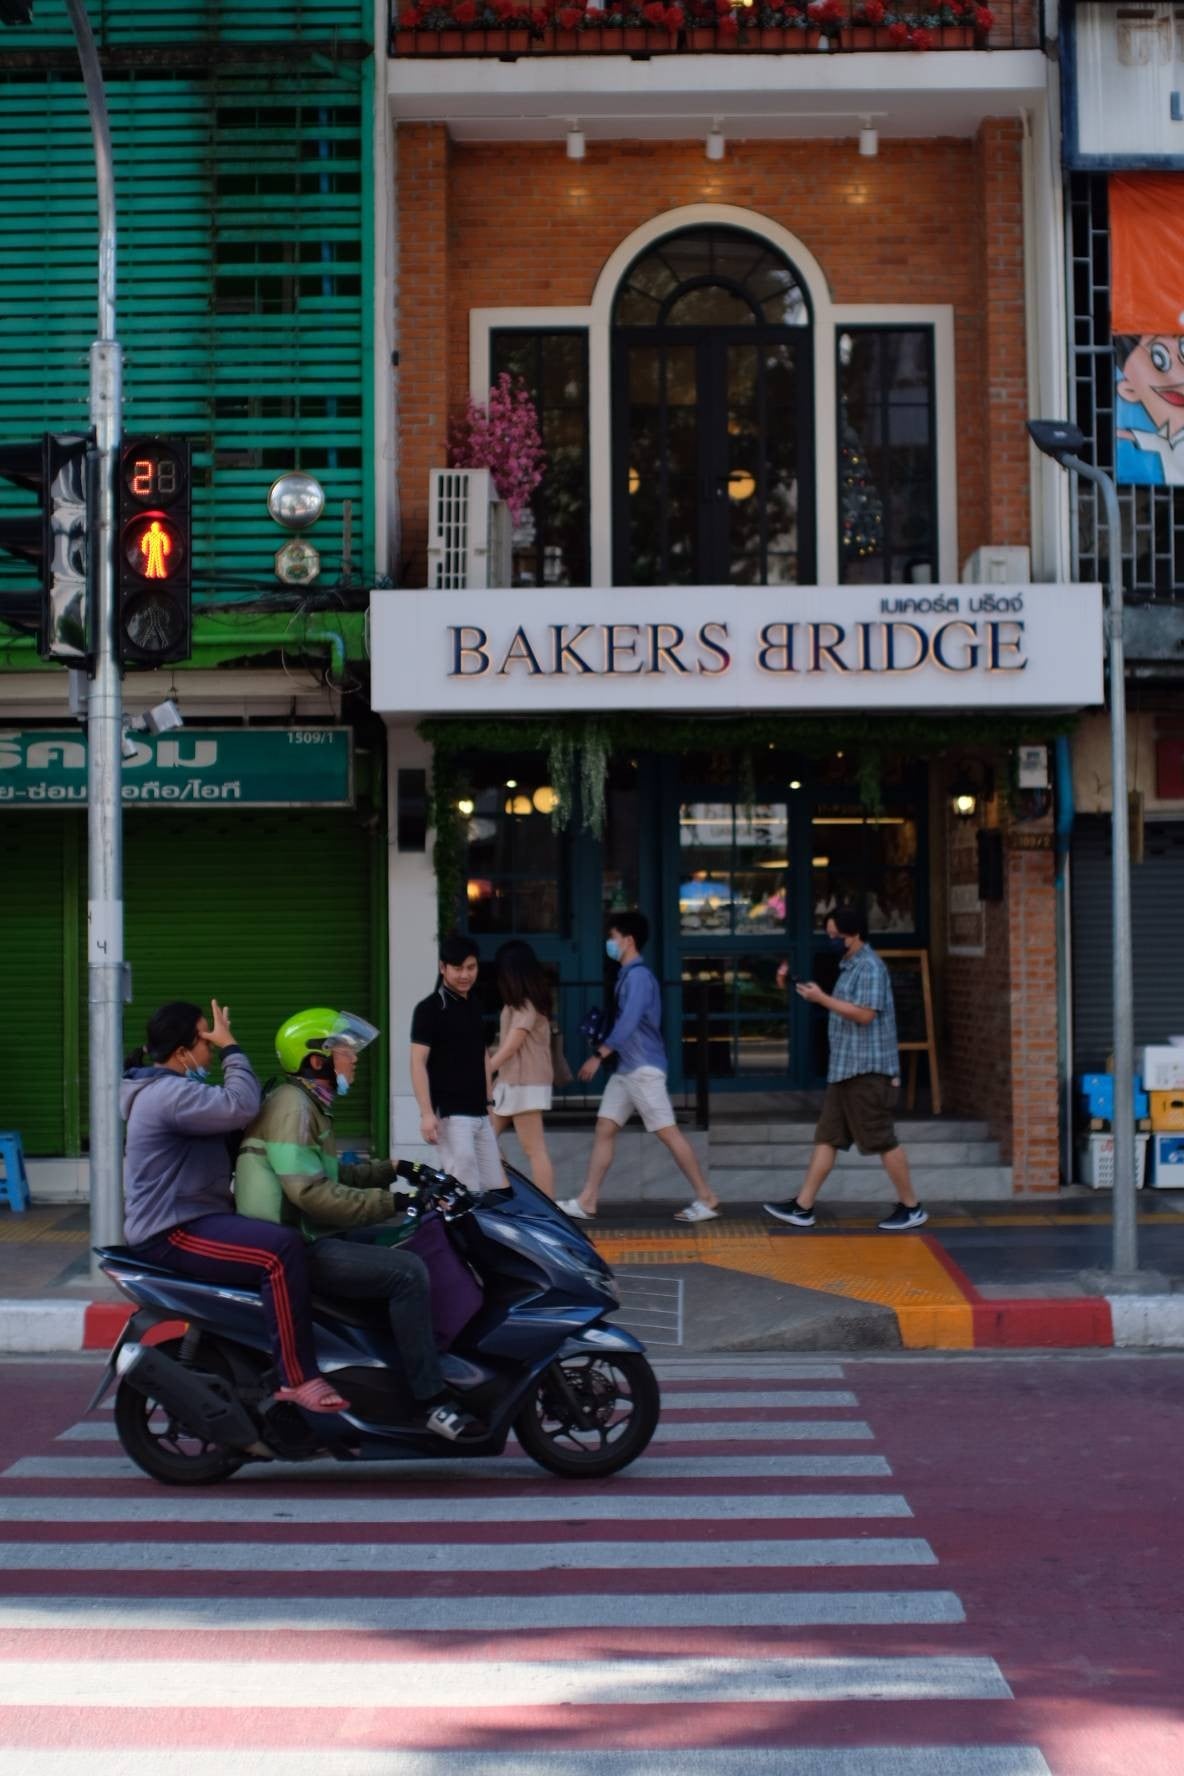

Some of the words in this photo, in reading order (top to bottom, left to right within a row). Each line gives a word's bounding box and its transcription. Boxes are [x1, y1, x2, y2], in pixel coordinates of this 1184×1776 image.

[880, 593, 960, 613] เบเคอร์ส
[447, 621, 732, 678] BAKERS
[757, 620, 1029, 675] BRIDGE
[287, 731, 334, 745] 1509/1
